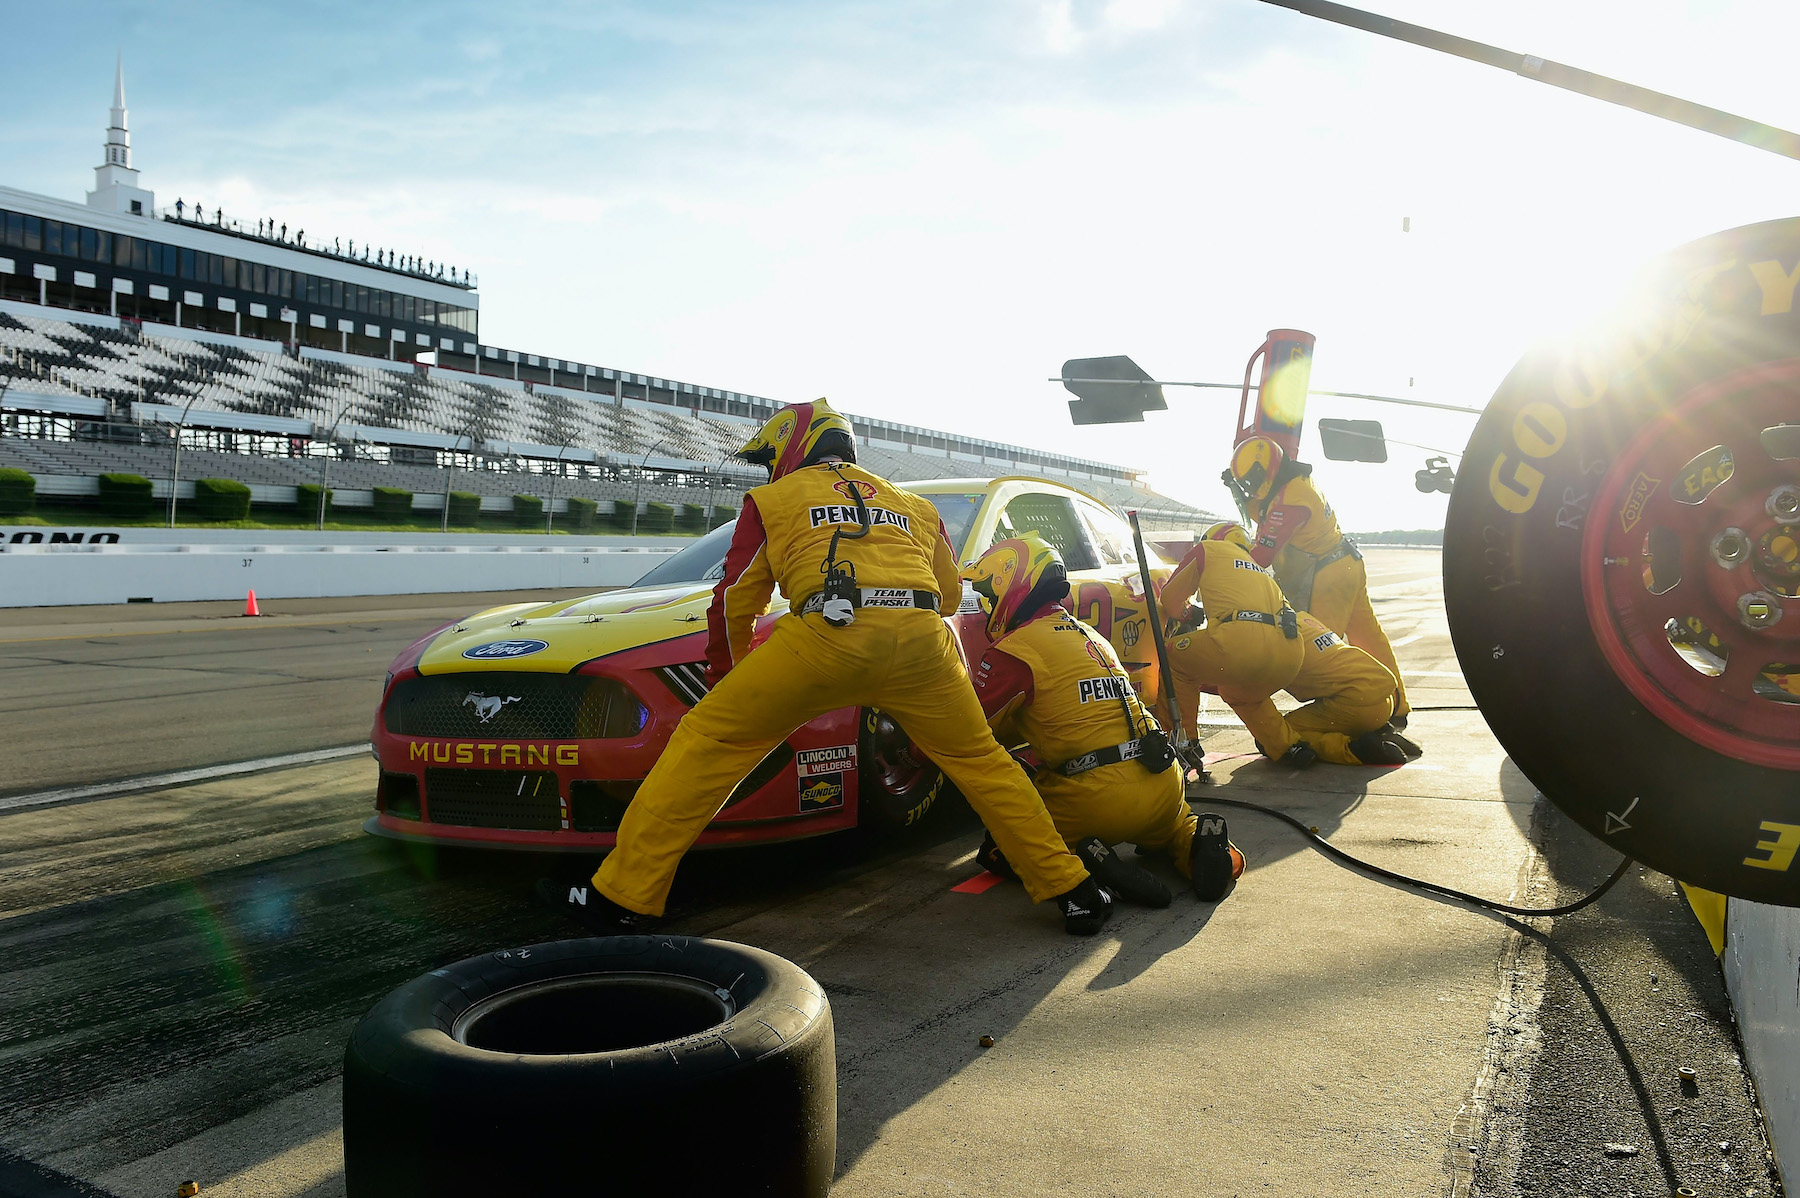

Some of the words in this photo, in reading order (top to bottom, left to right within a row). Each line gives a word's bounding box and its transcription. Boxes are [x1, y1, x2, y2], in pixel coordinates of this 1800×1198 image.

[1626, 481, 1648, 520] AERO
[873, 589, 908, 597] TEAM
[864, 599, 911, 607] PENSKE
[475, 640, 534, 656] Ford
[409, 741, 579, 766] MUSTANG
[800, 748, 847, 764] LINCOLN
[811, 760, 852, 773] WELDERS
[802, 785, 841, 800] SUNOCO
[1201, 819, 1224, 836] N
[568, 887, 587, 906] N
